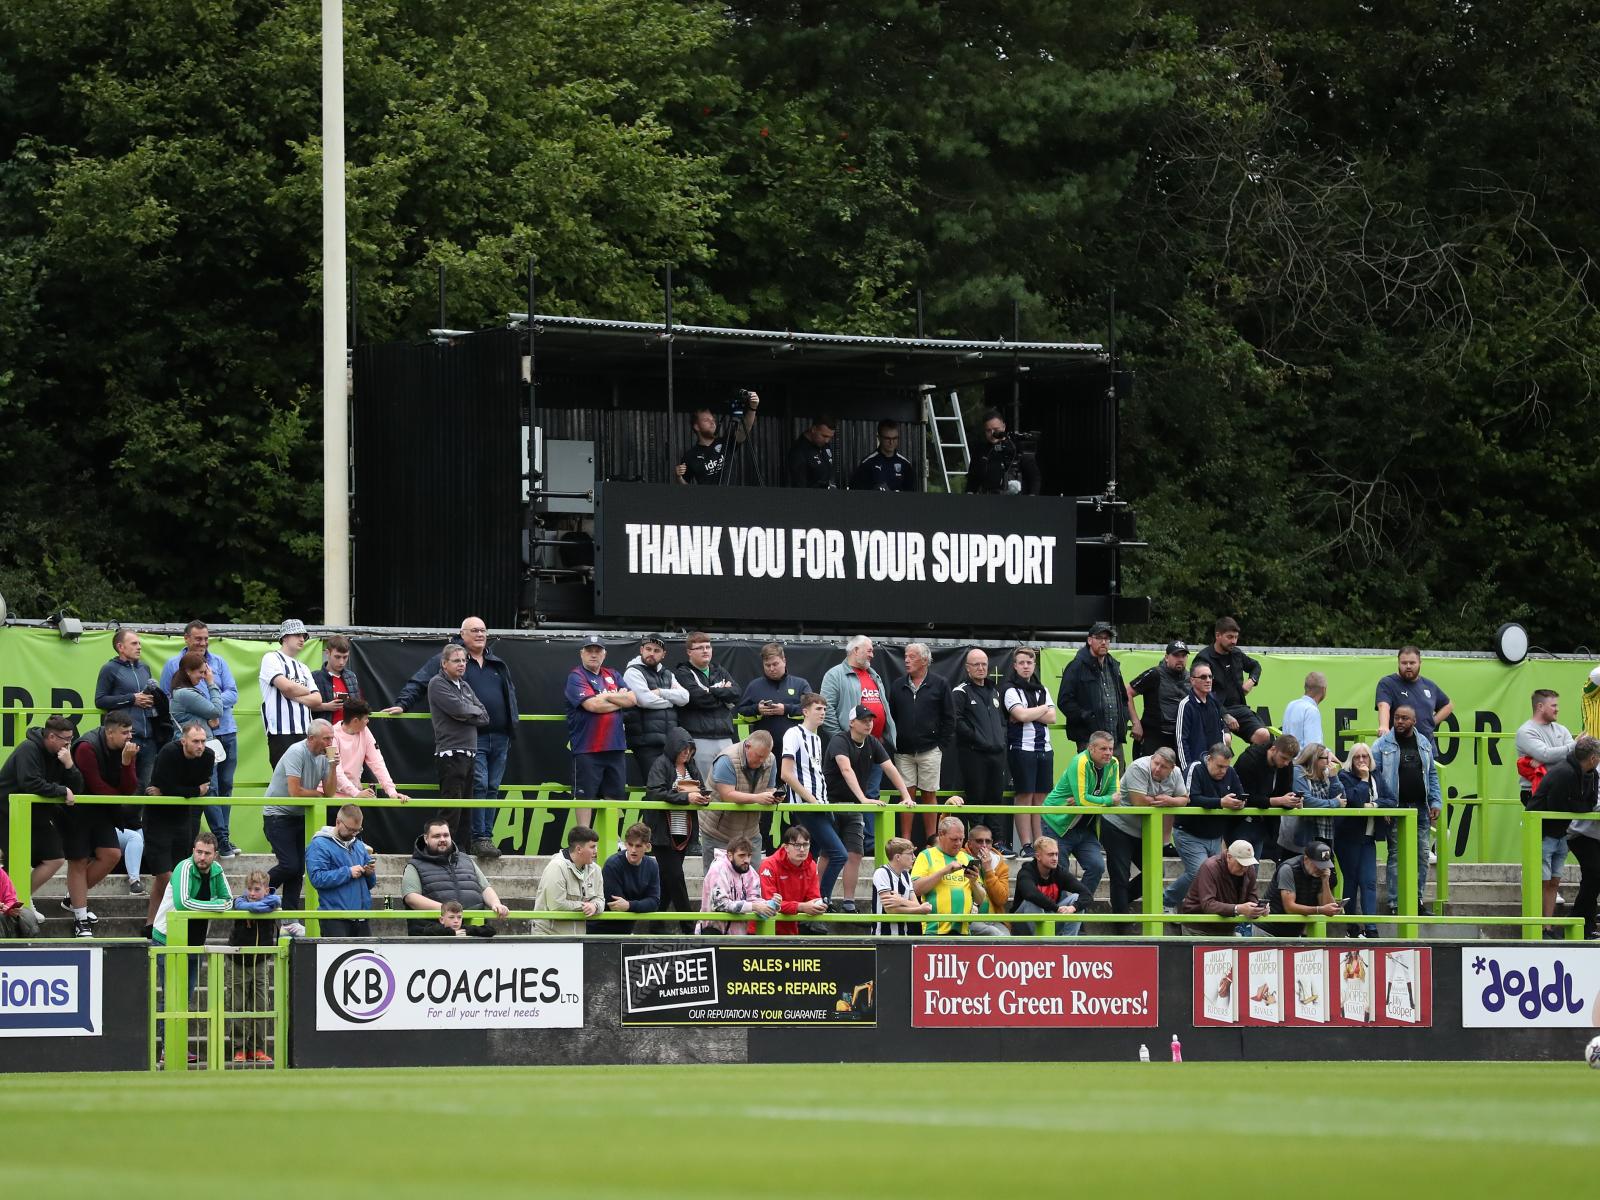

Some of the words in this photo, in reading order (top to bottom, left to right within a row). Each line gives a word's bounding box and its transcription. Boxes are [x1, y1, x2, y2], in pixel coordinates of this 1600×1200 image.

[625, 523, 723, 576] THANK
[728, 526, 785, 578] YOU
[792, 528, 846, 580] FOR
[850, 530, 926, 582] YOUR
[931, 532, 1056, 585] SUPPORT
[1209, 951, 1227, 962] JILLY
[1255, 951, 1271, 962] JILLY
[1300, 951, 1316, 962] JILLY
[635, 961, 669, 988] JAY
[675, 957, 708, 983] BEE
[742, 958, 783, 973] SALES
[792, 958, 821, 972] HIRE
[924, 953, 970, 985] Jilly
[977, 953, 1056, 985] Cooper
[1062, 954, 1113, 980] loves
[1204, 961, 1231, 975] COOPER
[1250, 961, 1276, 975] COOPER
[1296, 962, 1322, 975] COOPER
[343, 968, 383, 1006] KB
[406, 967, 561, 1004] COACHES
[561, 994, 579, 1004] LTD
[659, 988, 679, 998] PLANT
[680, 986, 698, 996] SALES
[698, 985, 710, 993] LTD
[726, 981, 776, 996] SPARES
[785, 981, 837, 996] REPAIRS
[924, 989, 992, 1016] Forest
[998, 989, 1064, 1016] Green
[1070, 989, 1149, 1016] Rovers!
[1388, 1001, 1412, 1018] Cooper
[427, 1007, 443, 1018] For
[446, 1007, 456, 1018] all
[460, 1008, 480, 1020] your
[484, 1007, 511, 1018] travel
[514, 1007, 540, 1018] needs
[688, 1009, 706, 1019] OUR
[706, 1009, 751, 1019] REPUTATION
[751, 1009, 759, 1019] IS
[760, 1009, 783, 1020] YOUR
[783, 1009, 828, 1020] GUARANTEE
